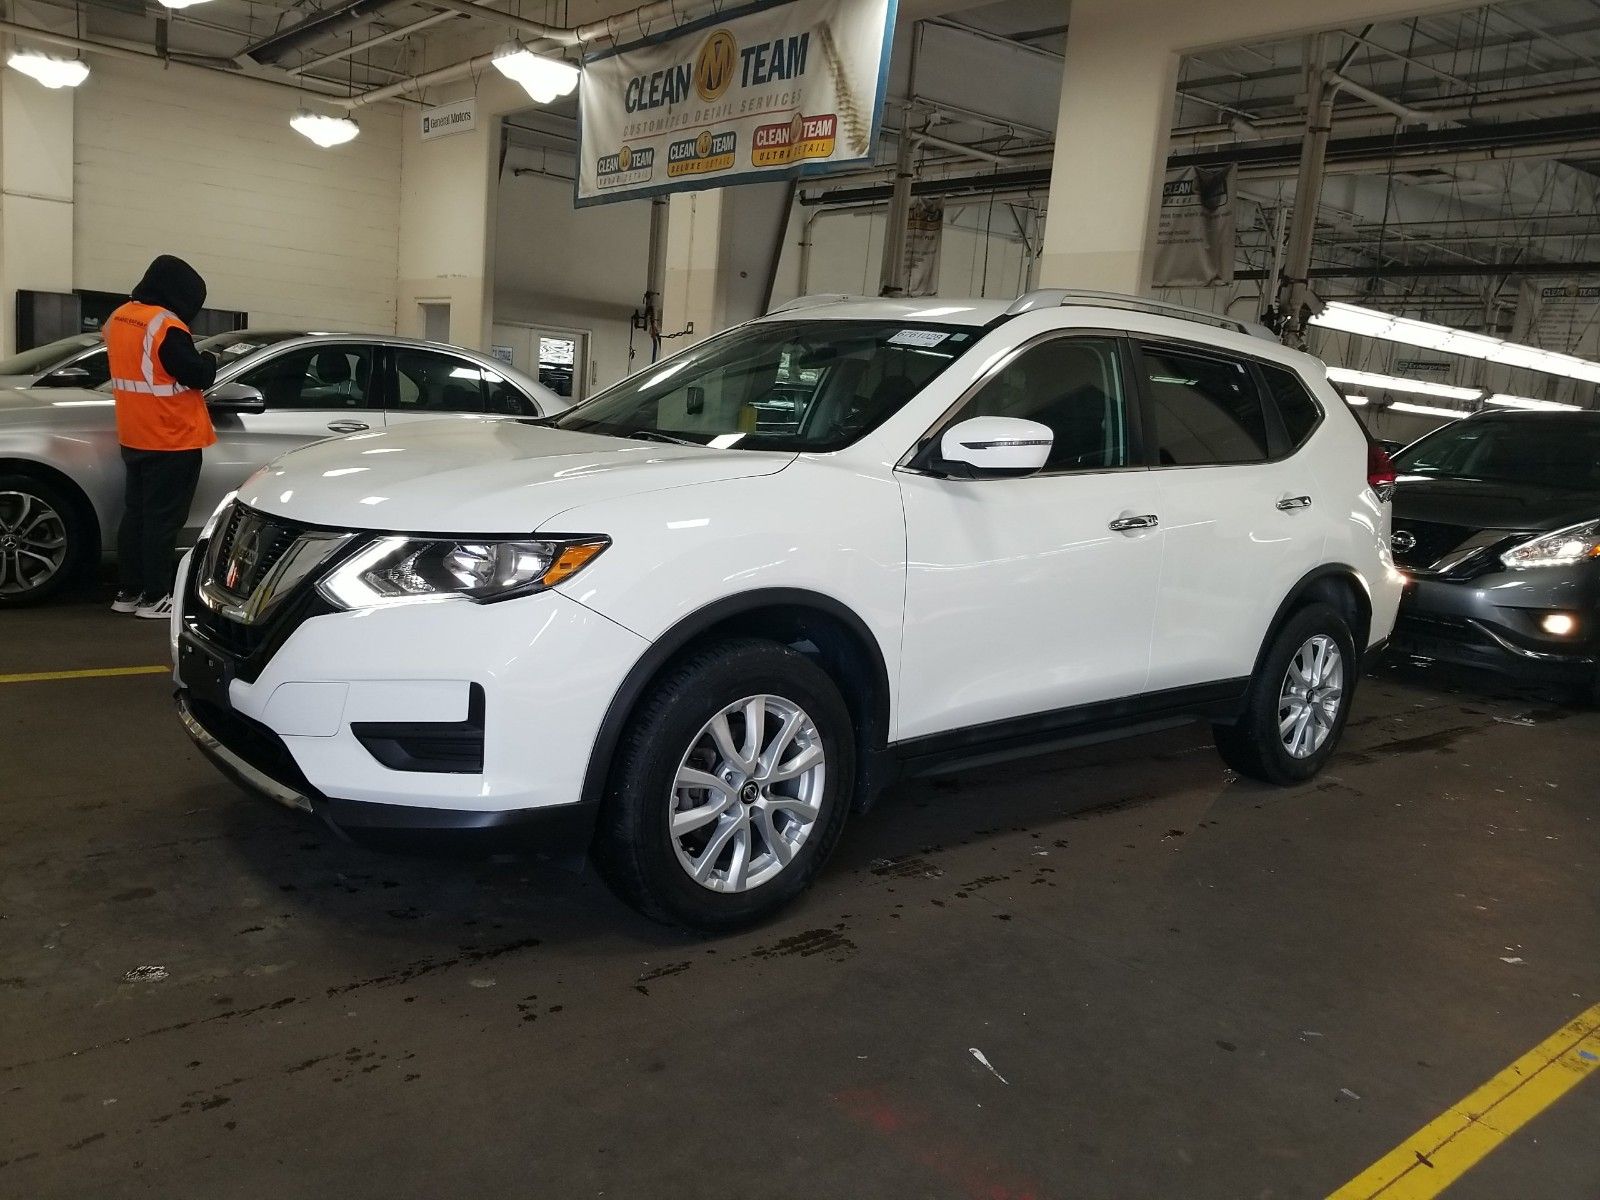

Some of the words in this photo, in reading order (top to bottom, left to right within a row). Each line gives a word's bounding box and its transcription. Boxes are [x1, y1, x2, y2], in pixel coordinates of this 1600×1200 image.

[625, 62, 692, 114] CLEAN
[740, 31, 810, 88] TEAM
[430, 114, 450, 128] General
[450, 111, 471, 124] Motors
[623, 112, 687, 137] CUSTOMIZED
[694, 105, 733, 123] DETAIL
[740, 89, 802, 113] SERVICES
[756, 127, 790, 146] CLEAN
[803, 119, 833, 138] TEAM
[670, 141, 695, 160] CLEAN
[713, 134, 735, 154] TEAM
[598, 156, 619, 173] CLEAN
[632, 150, 653, 167] TEAM
[1164, 181, 1191, 194] CLEAN
[1543, 288, 1565, 297] CLEAN
